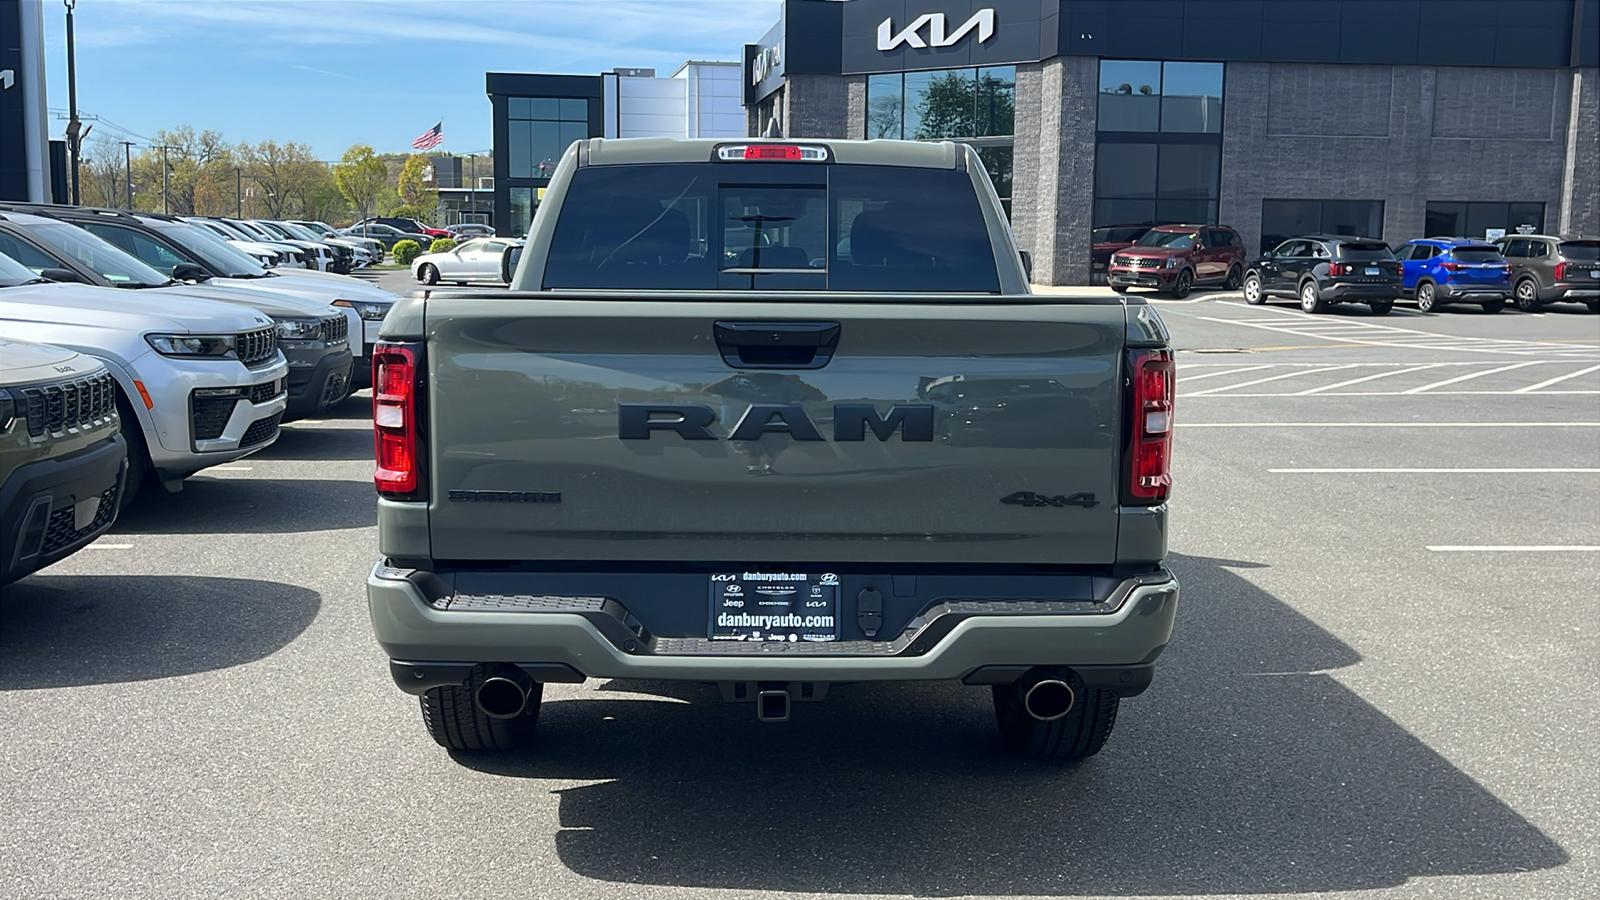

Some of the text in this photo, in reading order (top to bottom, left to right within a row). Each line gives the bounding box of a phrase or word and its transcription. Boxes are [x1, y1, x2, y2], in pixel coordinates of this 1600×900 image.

[877, 8, 994, 50] KIA
[618, 403, 935, 442] RAM
[999, 491, 1101, 508] 4x4
[742, 572, 806, 581] danburyauto.com
[723, 599, 744, 608] Jeep
[718, 612, 834, 629] danburyauto.com
